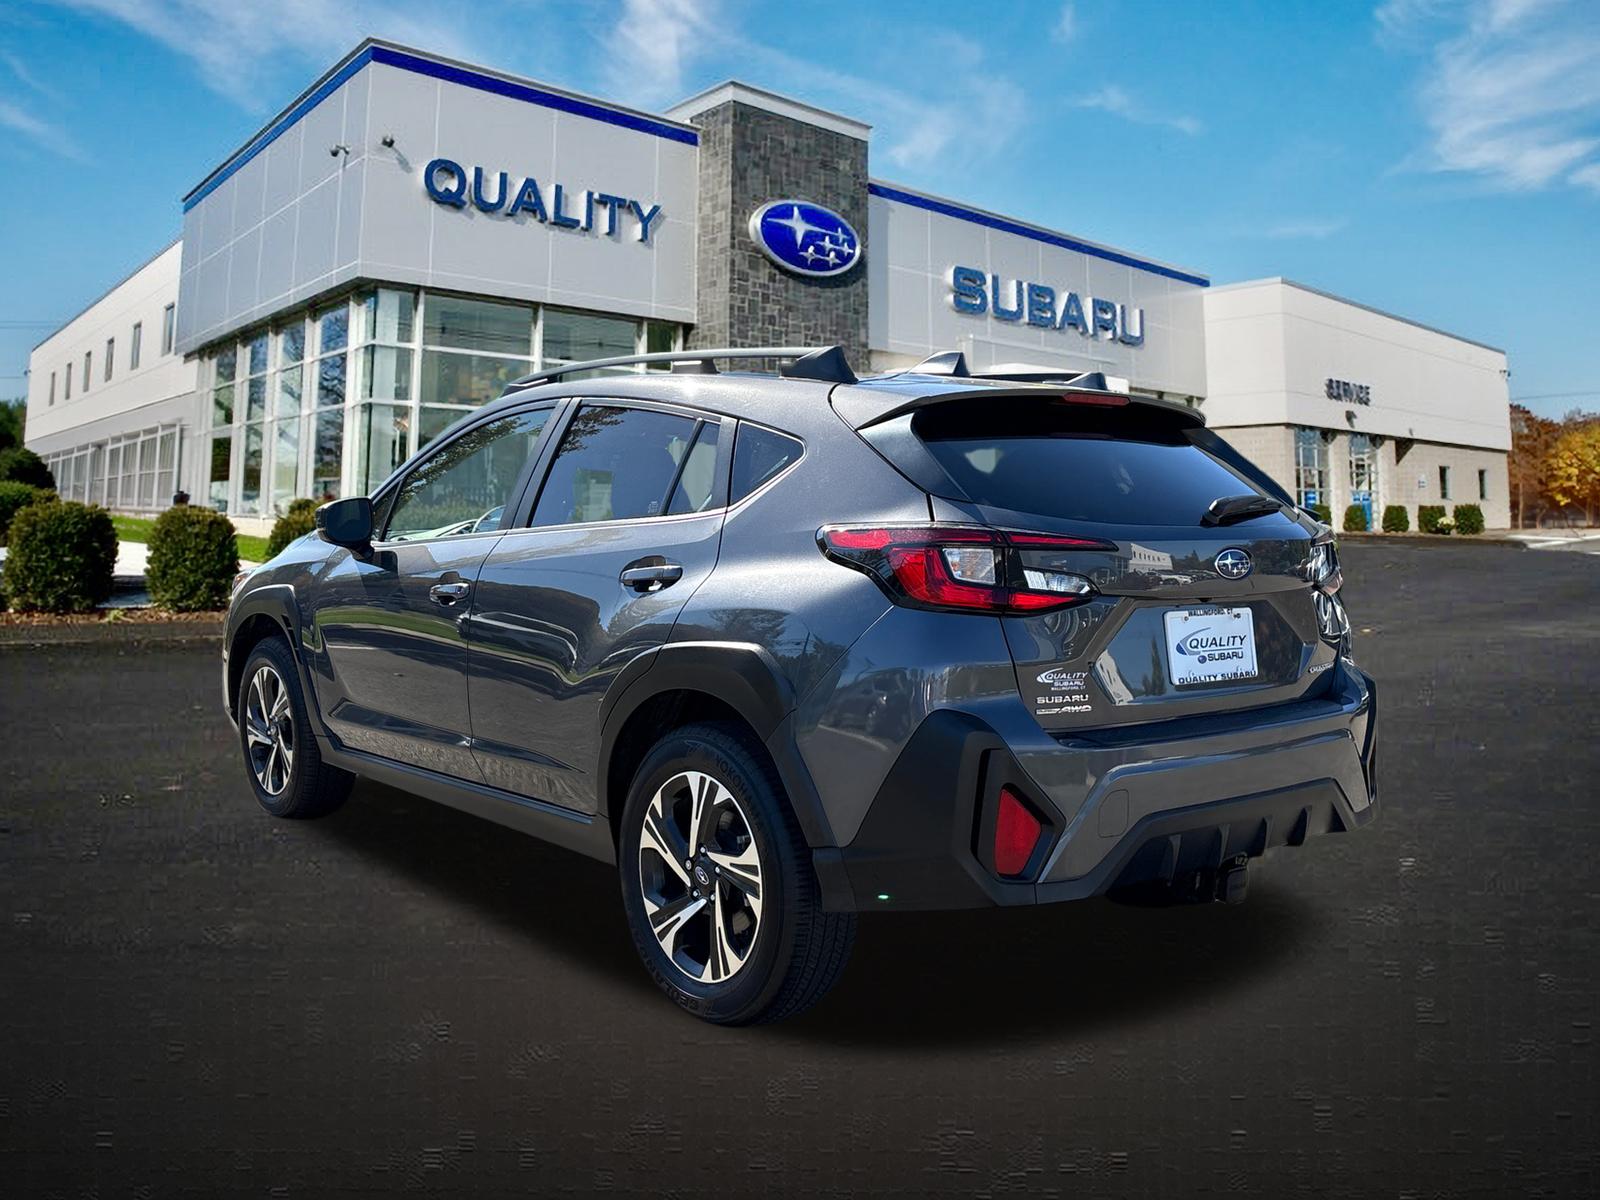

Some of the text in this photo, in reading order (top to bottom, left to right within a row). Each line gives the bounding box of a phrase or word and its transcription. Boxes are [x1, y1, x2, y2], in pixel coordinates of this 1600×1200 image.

[424, 158, 662, 243] QUALITY
[951, 265, 1145, 347] SUBARU
[1189, 635, 1247, 649] QUALITY
[1207, 651, 1244, 662] SUBARU
[1178, 670, 1256, 684] QUALITY SUBARU
[1036, 694, 1089, 704] SUBARU
